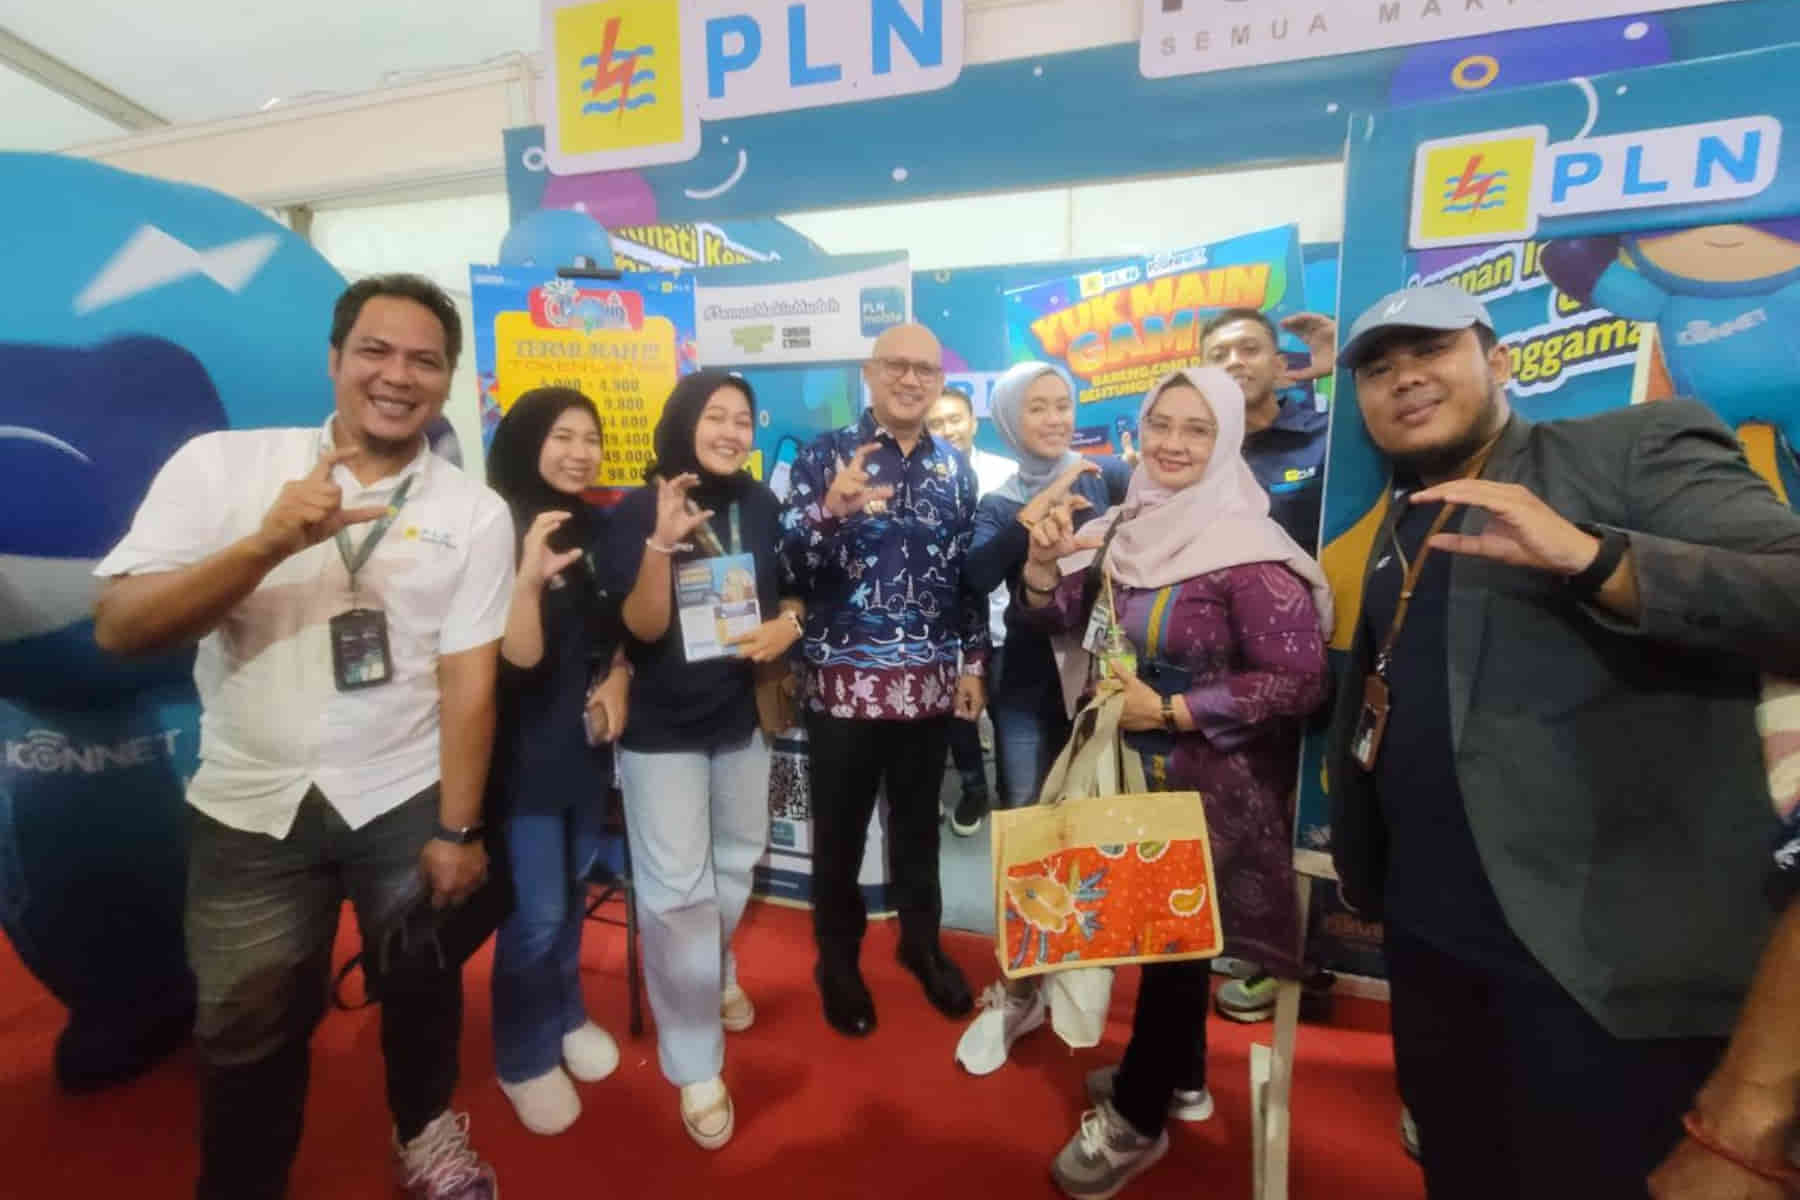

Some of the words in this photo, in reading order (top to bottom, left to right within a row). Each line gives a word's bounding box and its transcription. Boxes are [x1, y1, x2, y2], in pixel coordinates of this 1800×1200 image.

[706, 0, 943, 99] PLN
[1160, 13, 1328, 56] SEMUA
[1551, 130, 1762, 203] PLN
[1031, 288, 1128, 355] YUK
[1129, 264, 1269, 321] MAIN
